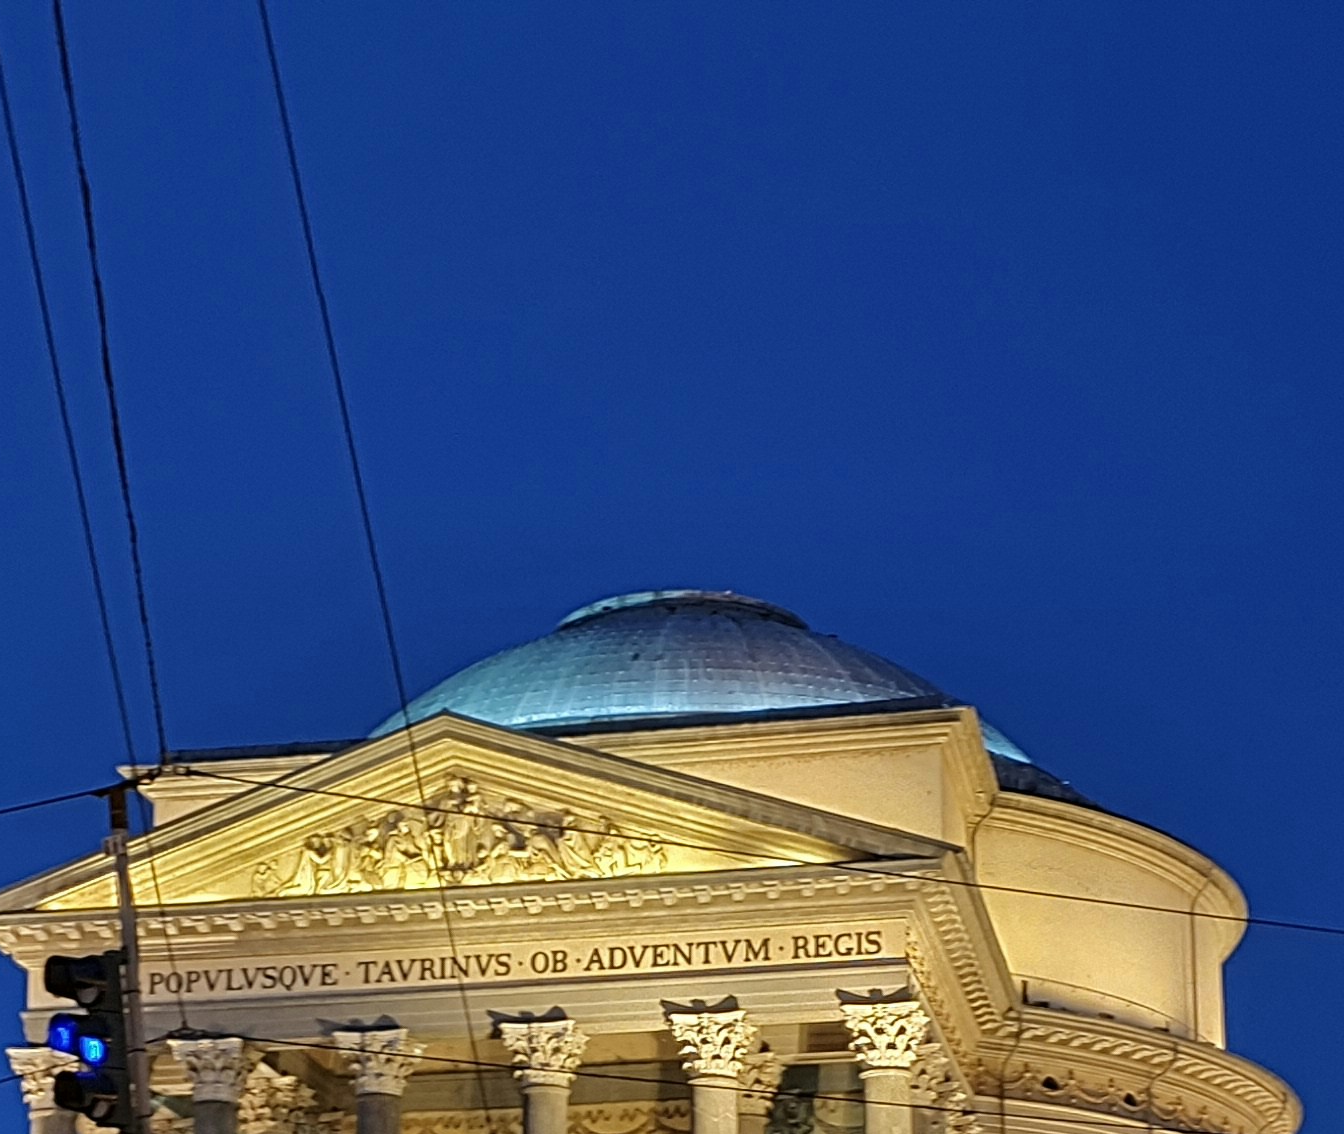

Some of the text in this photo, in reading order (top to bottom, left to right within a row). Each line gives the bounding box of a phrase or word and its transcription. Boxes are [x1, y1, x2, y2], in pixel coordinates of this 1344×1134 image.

[358, 953, 512, 984] TAVRINVS
[530, 950, 568, 974] OB
[583, 938, 771, 971] ADVENTVM
[793, 931, 882, 960] REGIS
